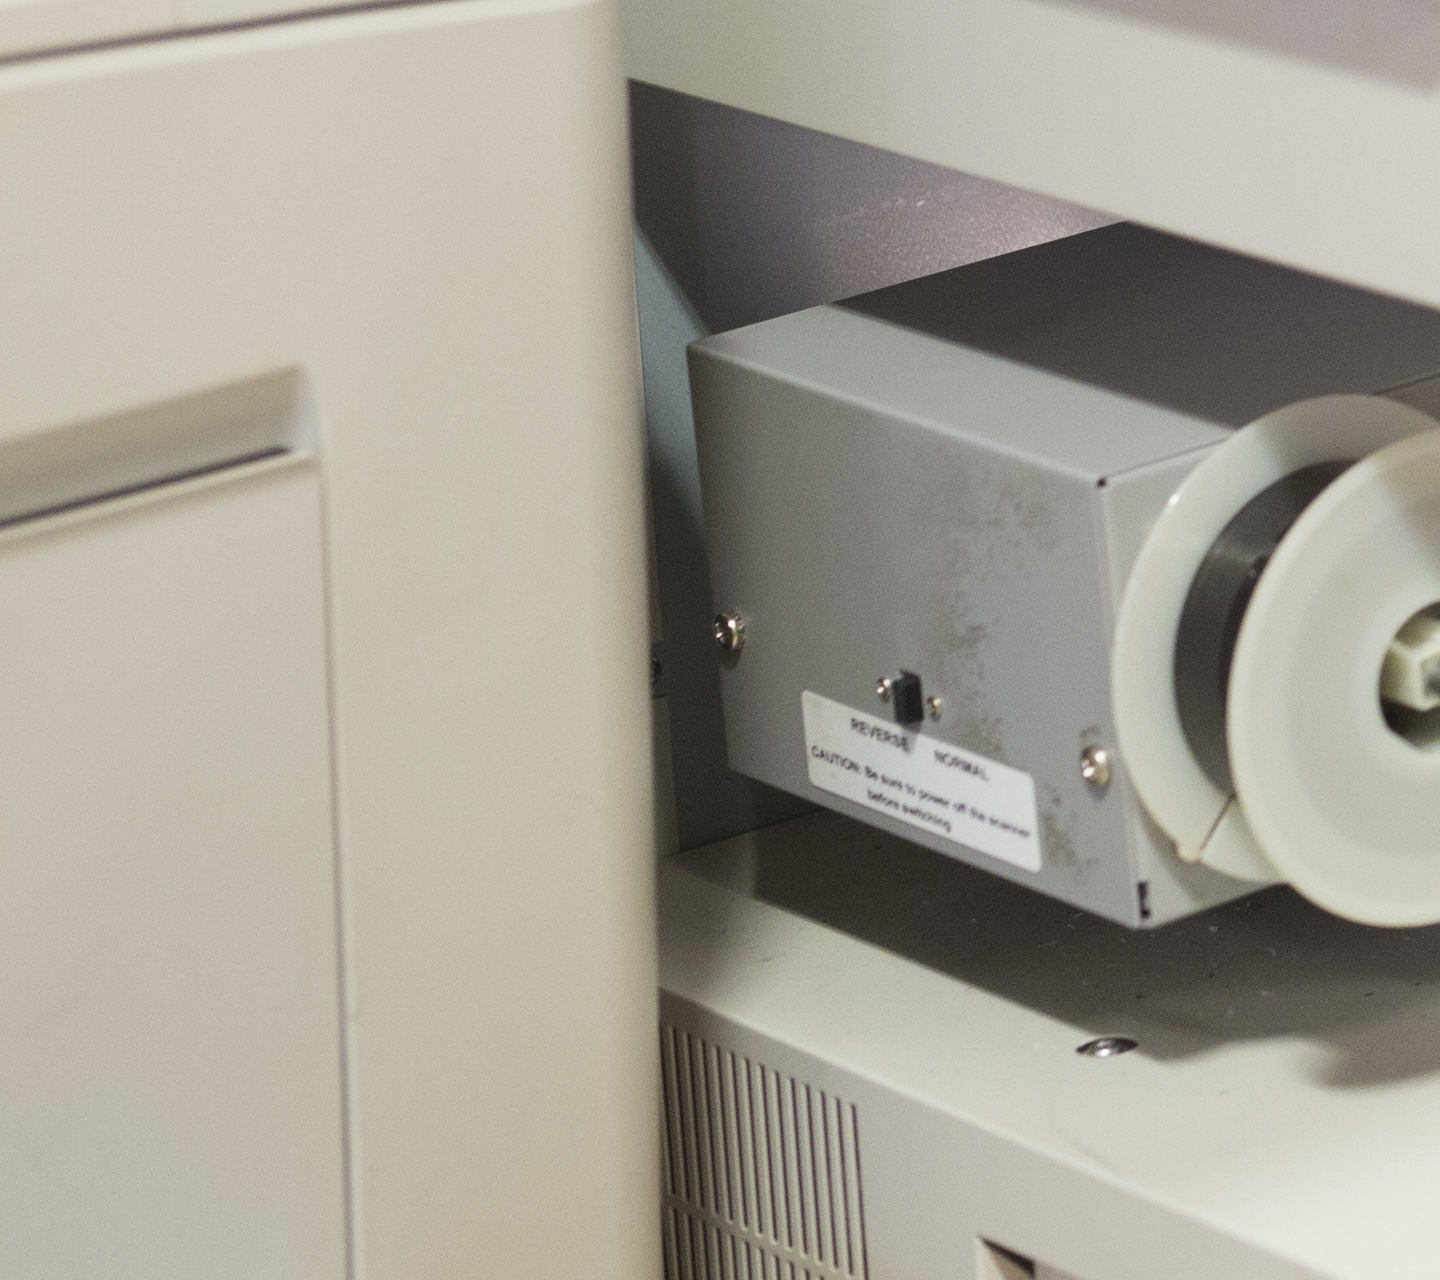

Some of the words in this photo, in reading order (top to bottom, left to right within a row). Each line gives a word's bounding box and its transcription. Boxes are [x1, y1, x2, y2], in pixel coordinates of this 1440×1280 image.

[850, 717, 912, 754] REVERSE
[933, 749, 990, 783] NORMAL
[866, 788, 900, 811] before
[902, 802, 952, 833] switching
[881, 774, 903, 791] sure
[905, 782, 917, 797] to
[918, 789, 950, 808] power
[953, 800, 968, 815] off
[969, 806, 986, 822] the
[989, 816, 1031, 838] scanner
